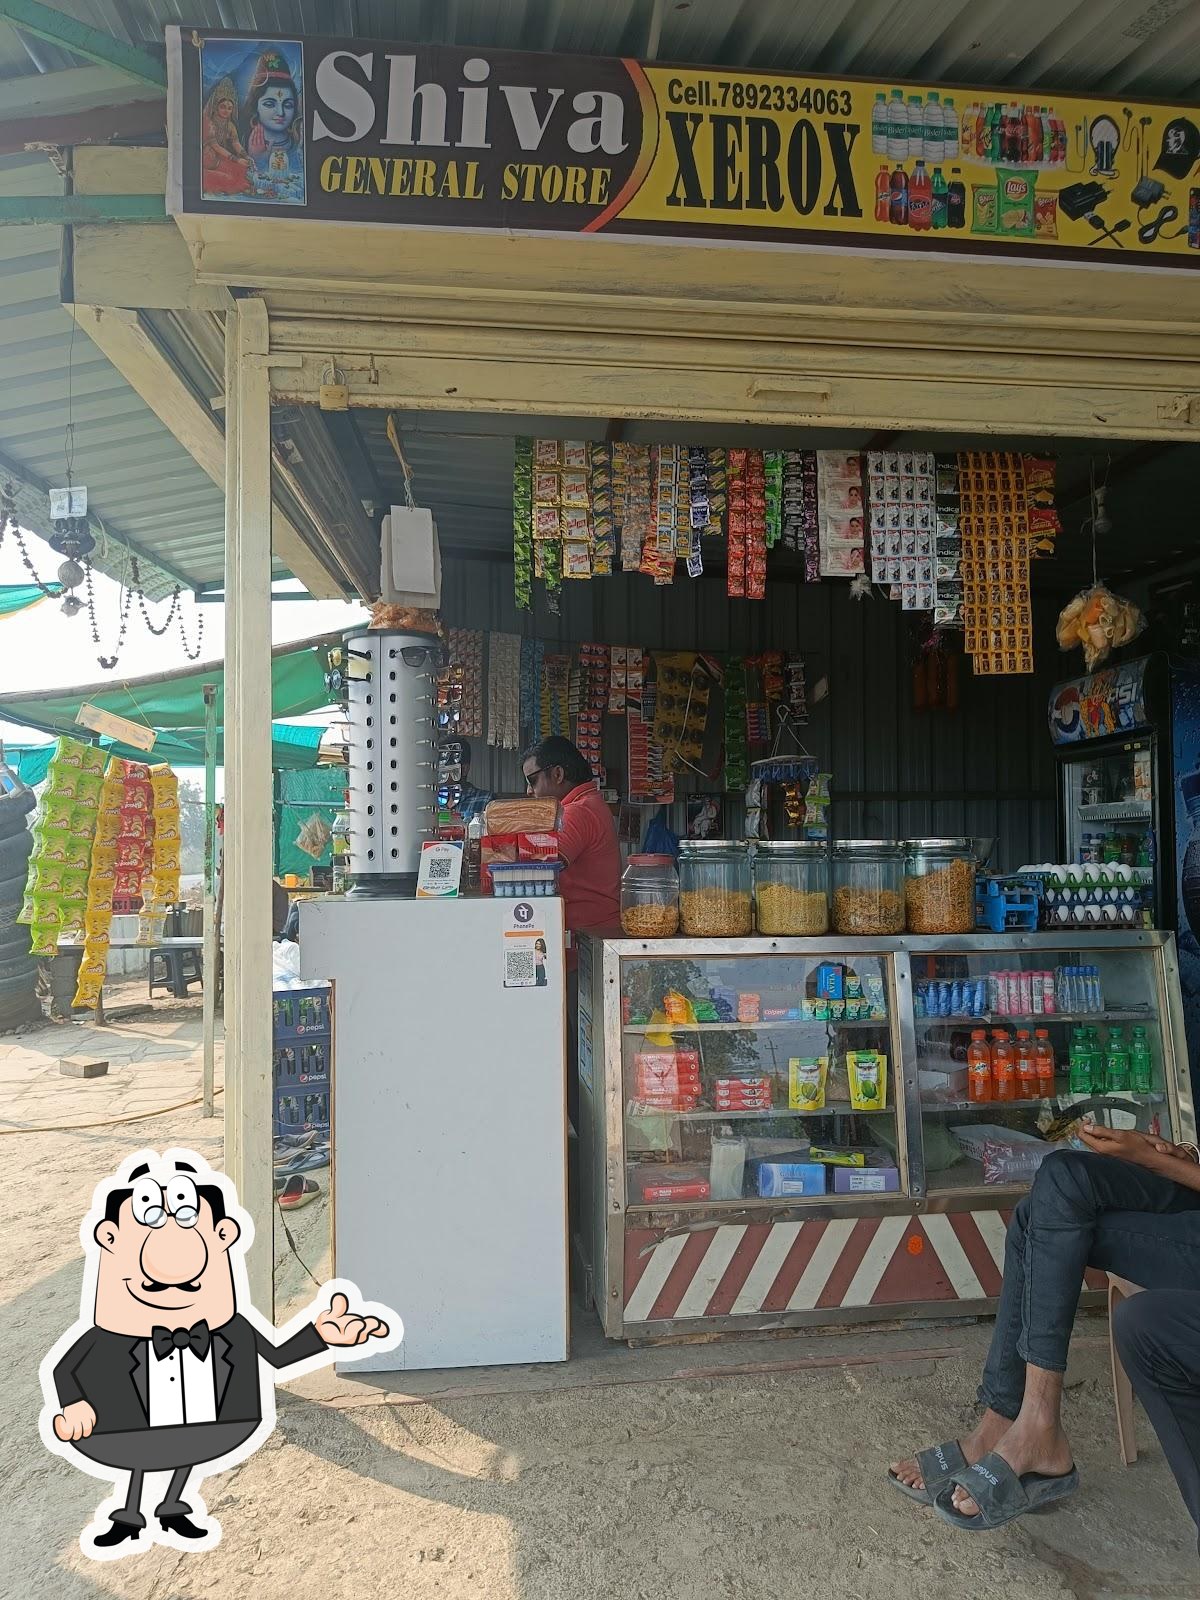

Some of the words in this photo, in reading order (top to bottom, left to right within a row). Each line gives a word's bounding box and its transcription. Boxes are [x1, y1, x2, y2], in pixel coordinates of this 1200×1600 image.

[311, 49, 630, 155] Shiva
[667, 78, 853, 117] Cell.7892334063
[319, 156, 485, 201] GENERAL
[500, 163, 613, 206] STORE
[664, 111, 864, 218] XEROX
[306, 1023, 325, 1032] pepsi
[308, 1073, 327, 1082] pepsi
